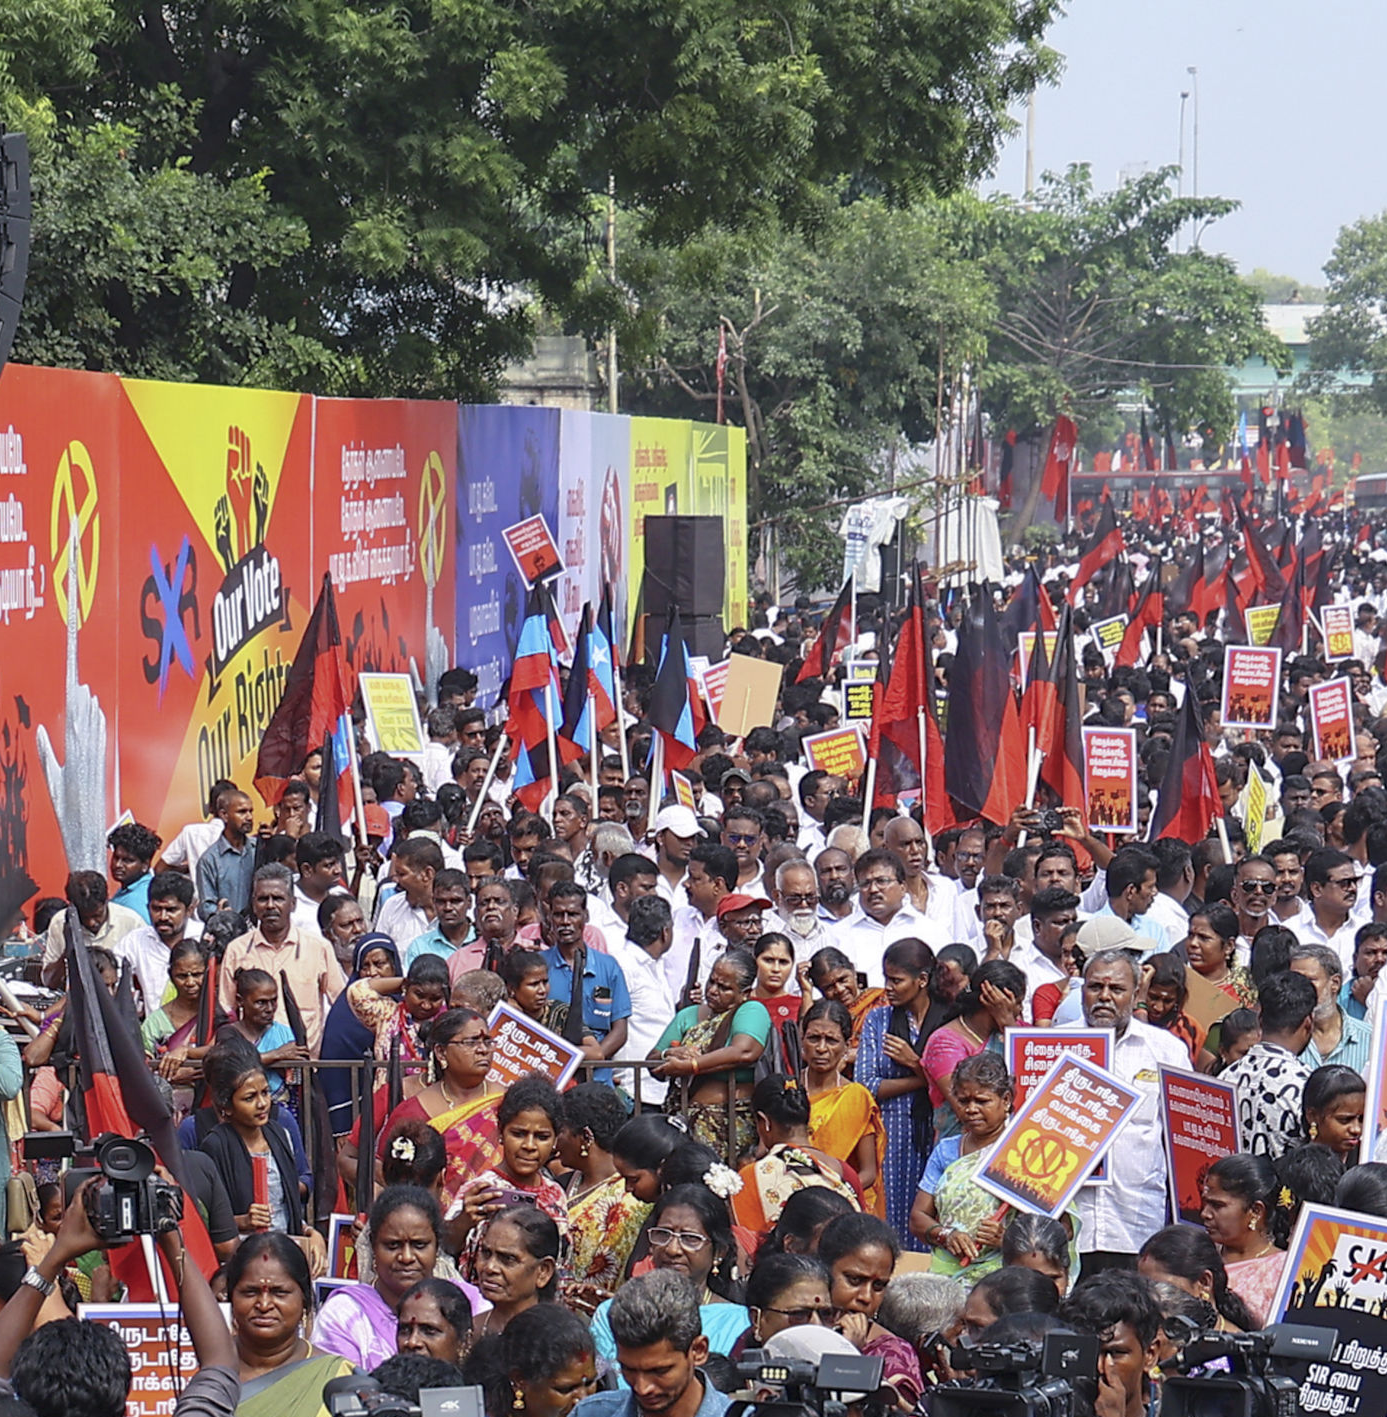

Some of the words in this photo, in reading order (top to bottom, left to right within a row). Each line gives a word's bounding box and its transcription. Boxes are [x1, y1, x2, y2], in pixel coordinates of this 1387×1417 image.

[213, 589, 243, 662] Our
[242, 551, 280, 631] Vote
[198, 706, 231, 820] Our
[1306, 1363, 1328, 1386] SIR
[1329, 1371, 1361, 1391] யை
